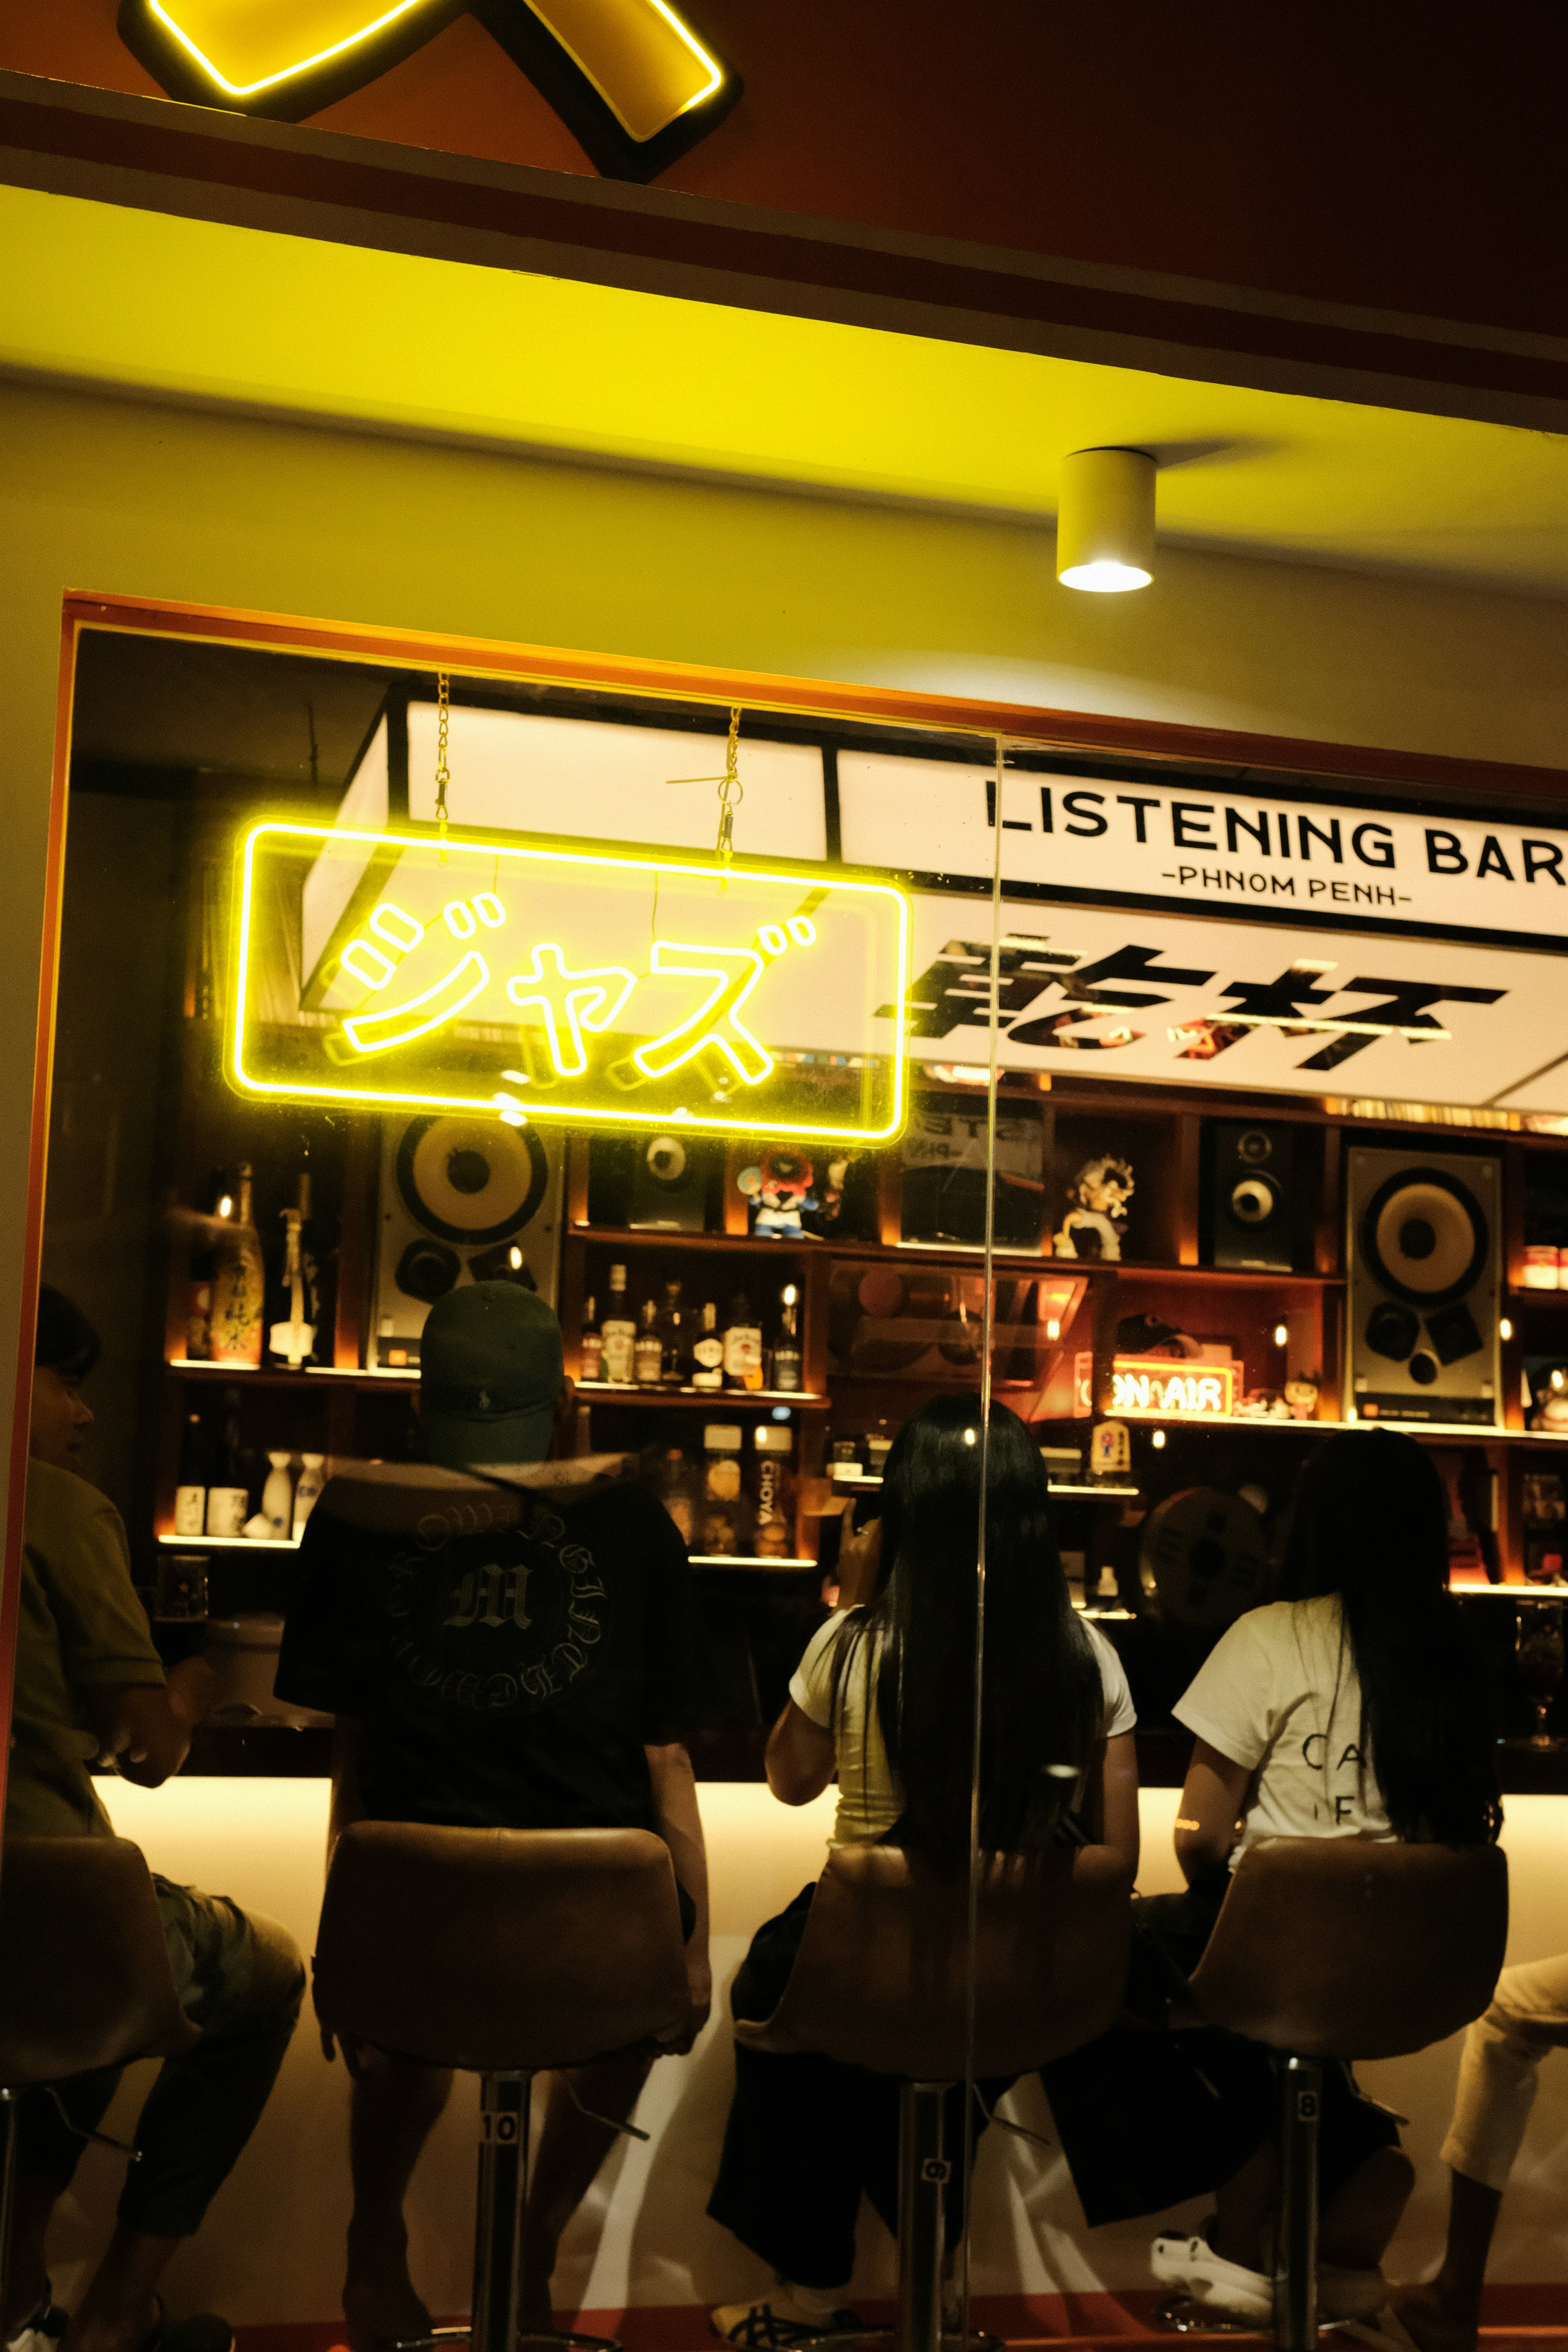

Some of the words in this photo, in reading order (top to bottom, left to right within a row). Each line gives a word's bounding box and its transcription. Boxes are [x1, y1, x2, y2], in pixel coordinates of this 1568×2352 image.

[984, 781, 1396, 869] LISTENING
[1425, 828, 1566, 886] BAR
[1162, 866, 1295, 897] -PHNOM
[1309, 880, 1412, 906] PENH-
[340, 891, 817, 1084] ジャズ
[872, 933, 1512, 1071] 乾杯
[1159, 1376, 1222, 1411] AIR
[443, 1563, 534, 1630] M
[484, 2115, 516, 2140] 10
[1301, 2096, 1315, 2118] 8
